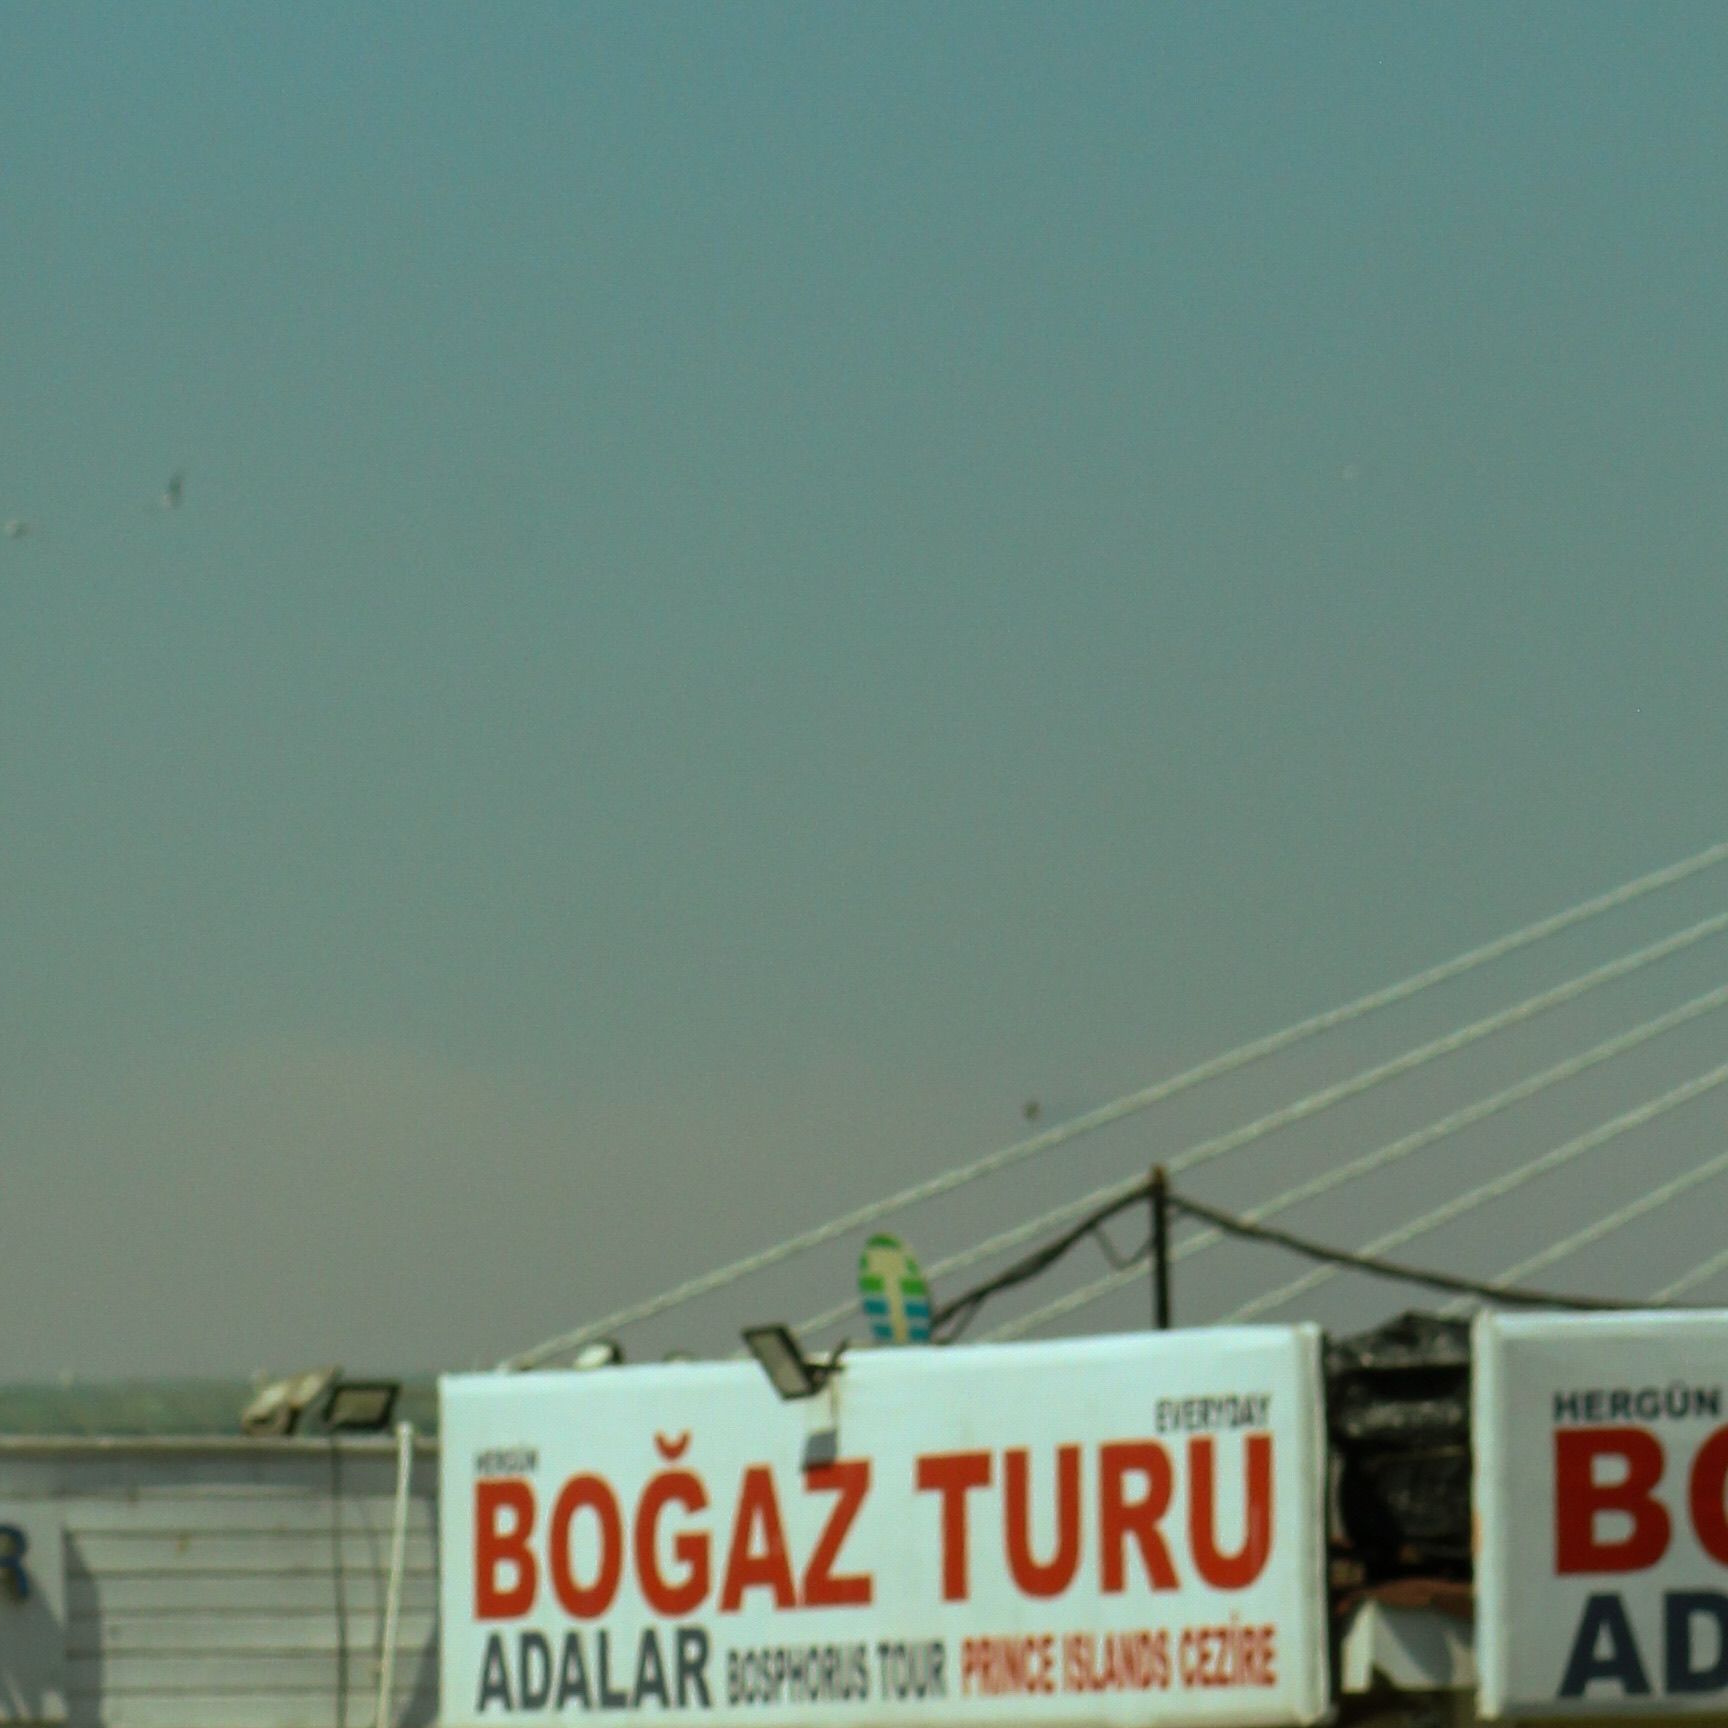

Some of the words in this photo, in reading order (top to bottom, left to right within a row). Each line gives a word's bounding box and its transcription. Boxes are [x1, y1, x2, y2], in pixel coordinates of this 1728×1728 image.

[1155, 1393, 1271, 1433] EVERYDAY
[1553, 1382, 1722, 1421] HERGÜN
[474, 1431, 873, 1622] BOĞAZ
[916, 1434, 1274, 1603] TURU
[476, 1627, 713, 1714] ADALAR
[726, 1643, 869, 1706] BOSPHORUS
[876, 1640, 947, 1701] TOUR
[960, 1634, 1056, 1696] PRINCE
[1062, 1629, 1170, 1692] ISLANDS
